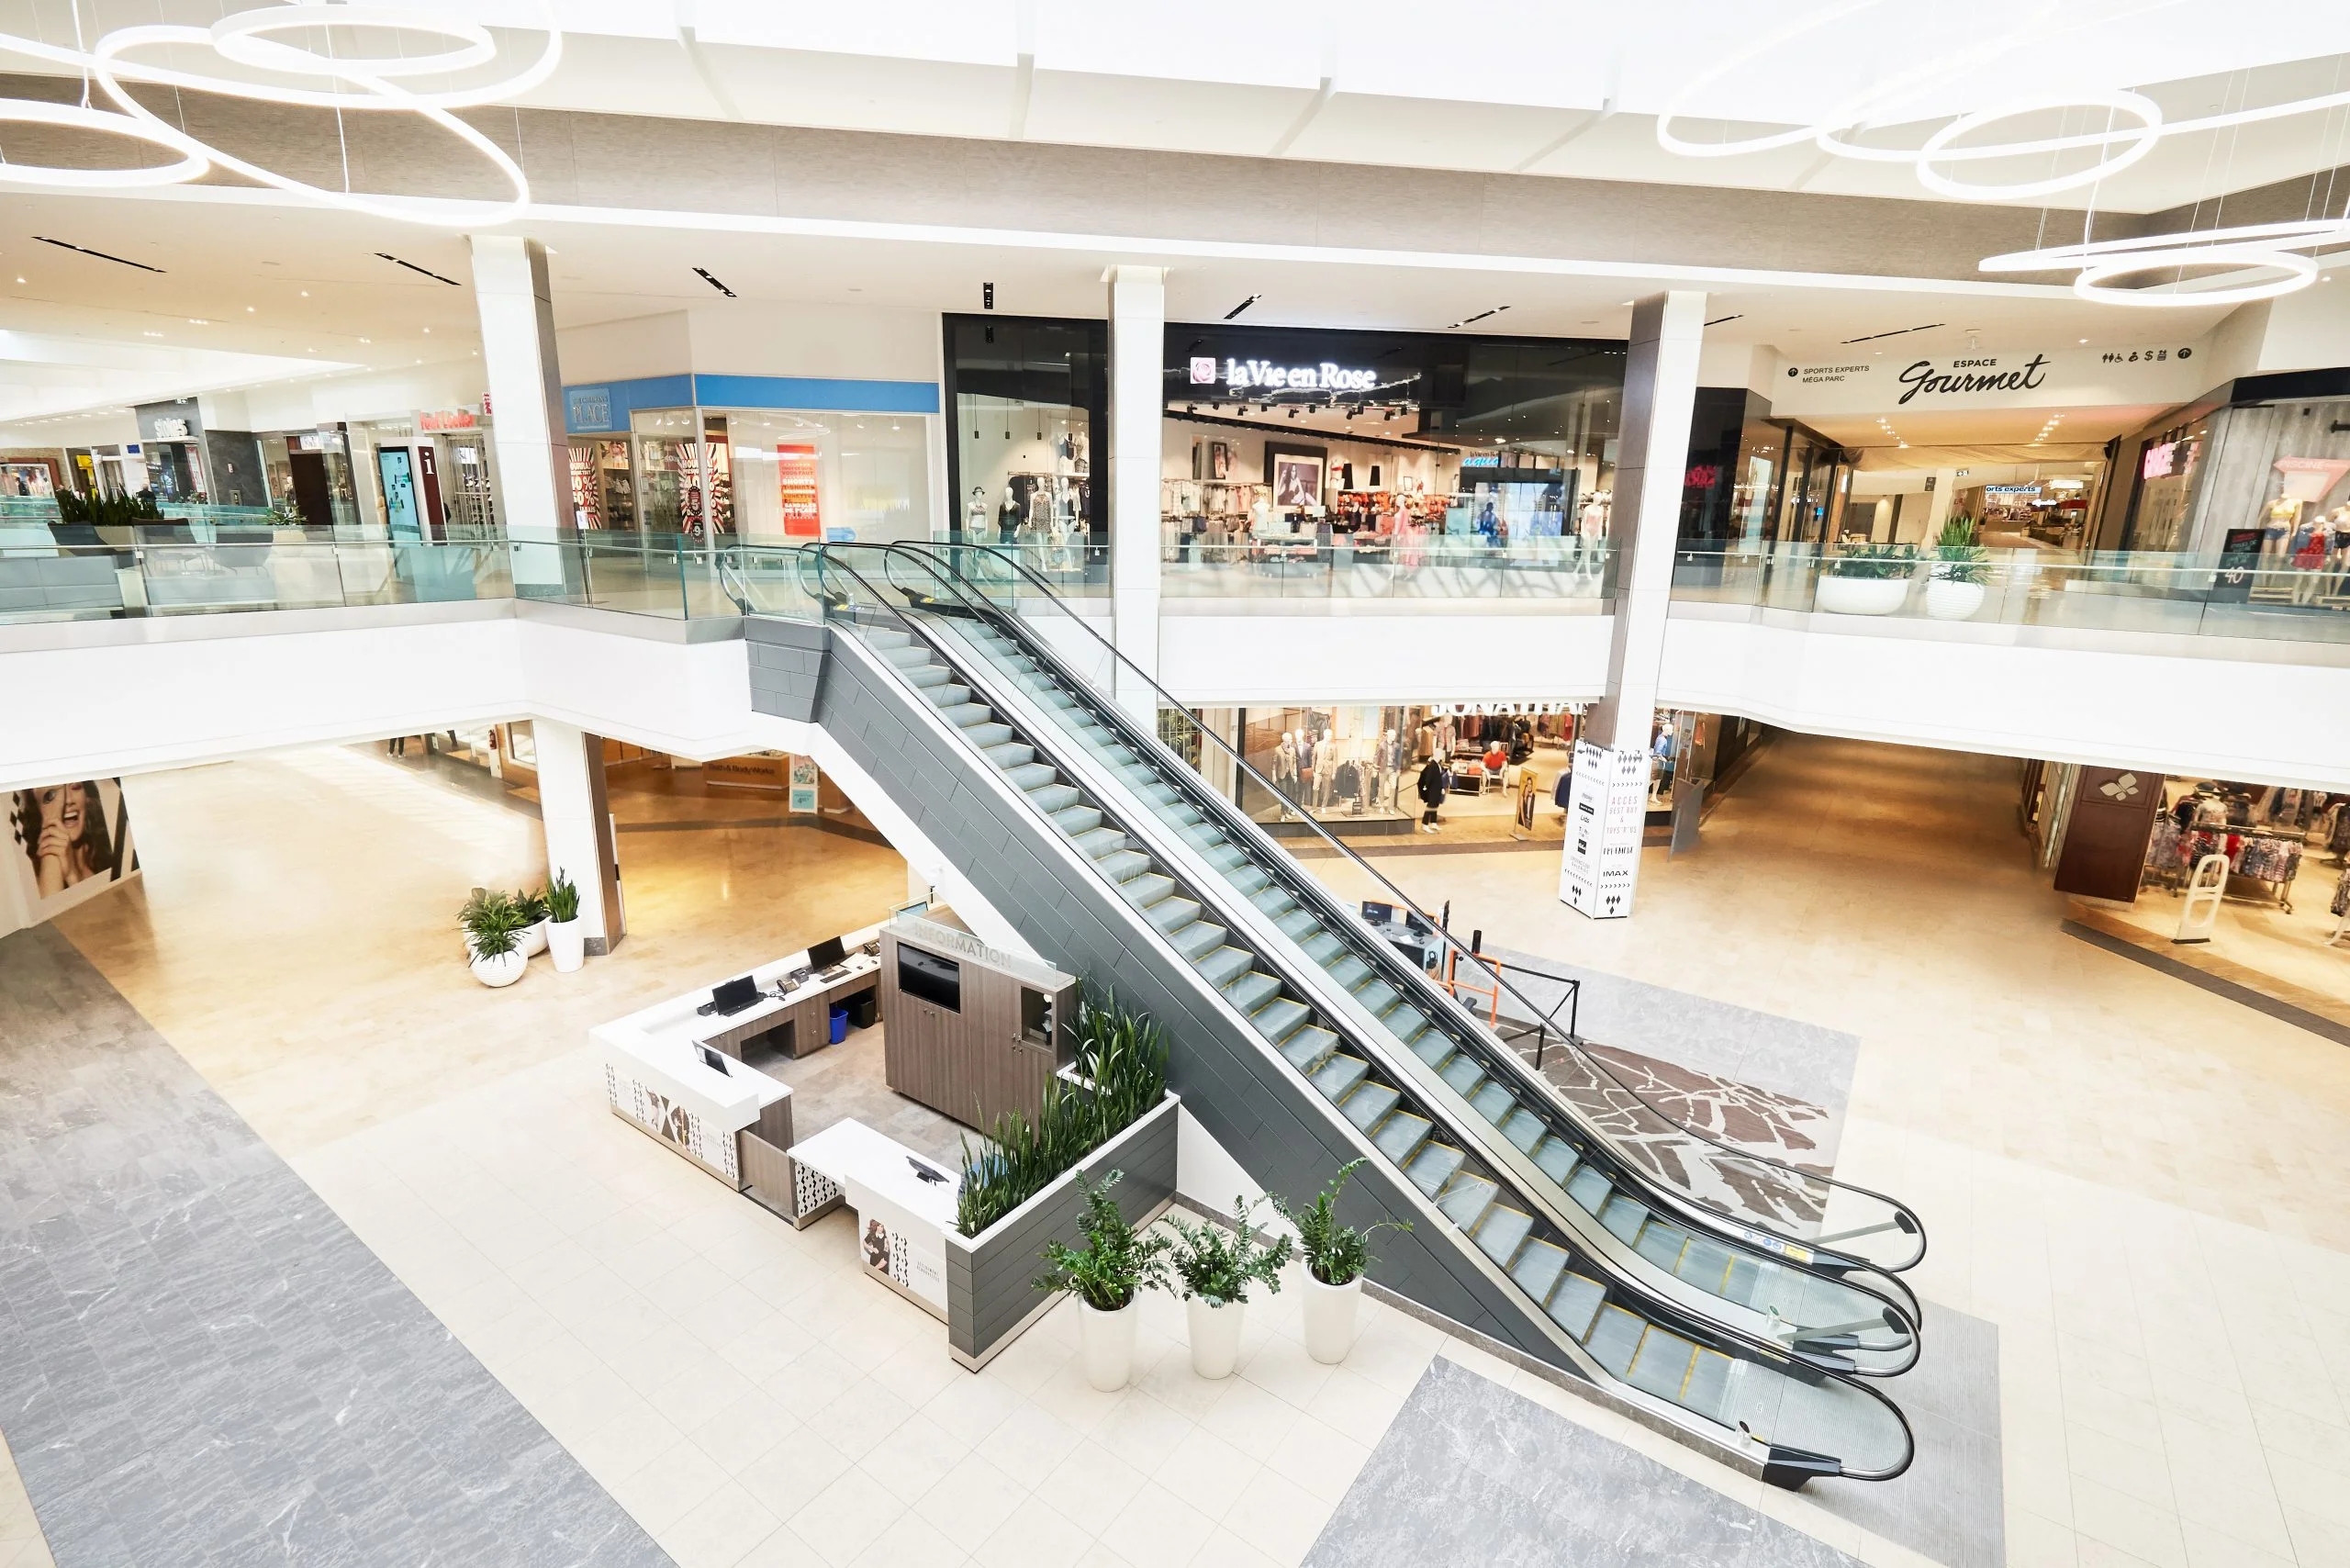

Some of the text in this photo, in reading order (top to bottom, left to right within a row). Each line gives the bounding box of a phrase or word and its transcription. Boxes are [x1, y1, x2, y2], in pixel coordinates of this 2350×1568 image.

[1835, 365, 1870, 374] EXPERTS
[1953, 358, 1998, 368] ESPACE
[1287, 366, 1318, 387] en
[1319, 363, 1377, 389] Rose
[1825, 375, 1845, 383] PARC
[1897, 353, 2051, 405] Gourmet
[573, 403, 610, 424] PLACE
[1603, 869, 1628, 878] IMAX
[914, 921, 1012, 968] INFORMATION
